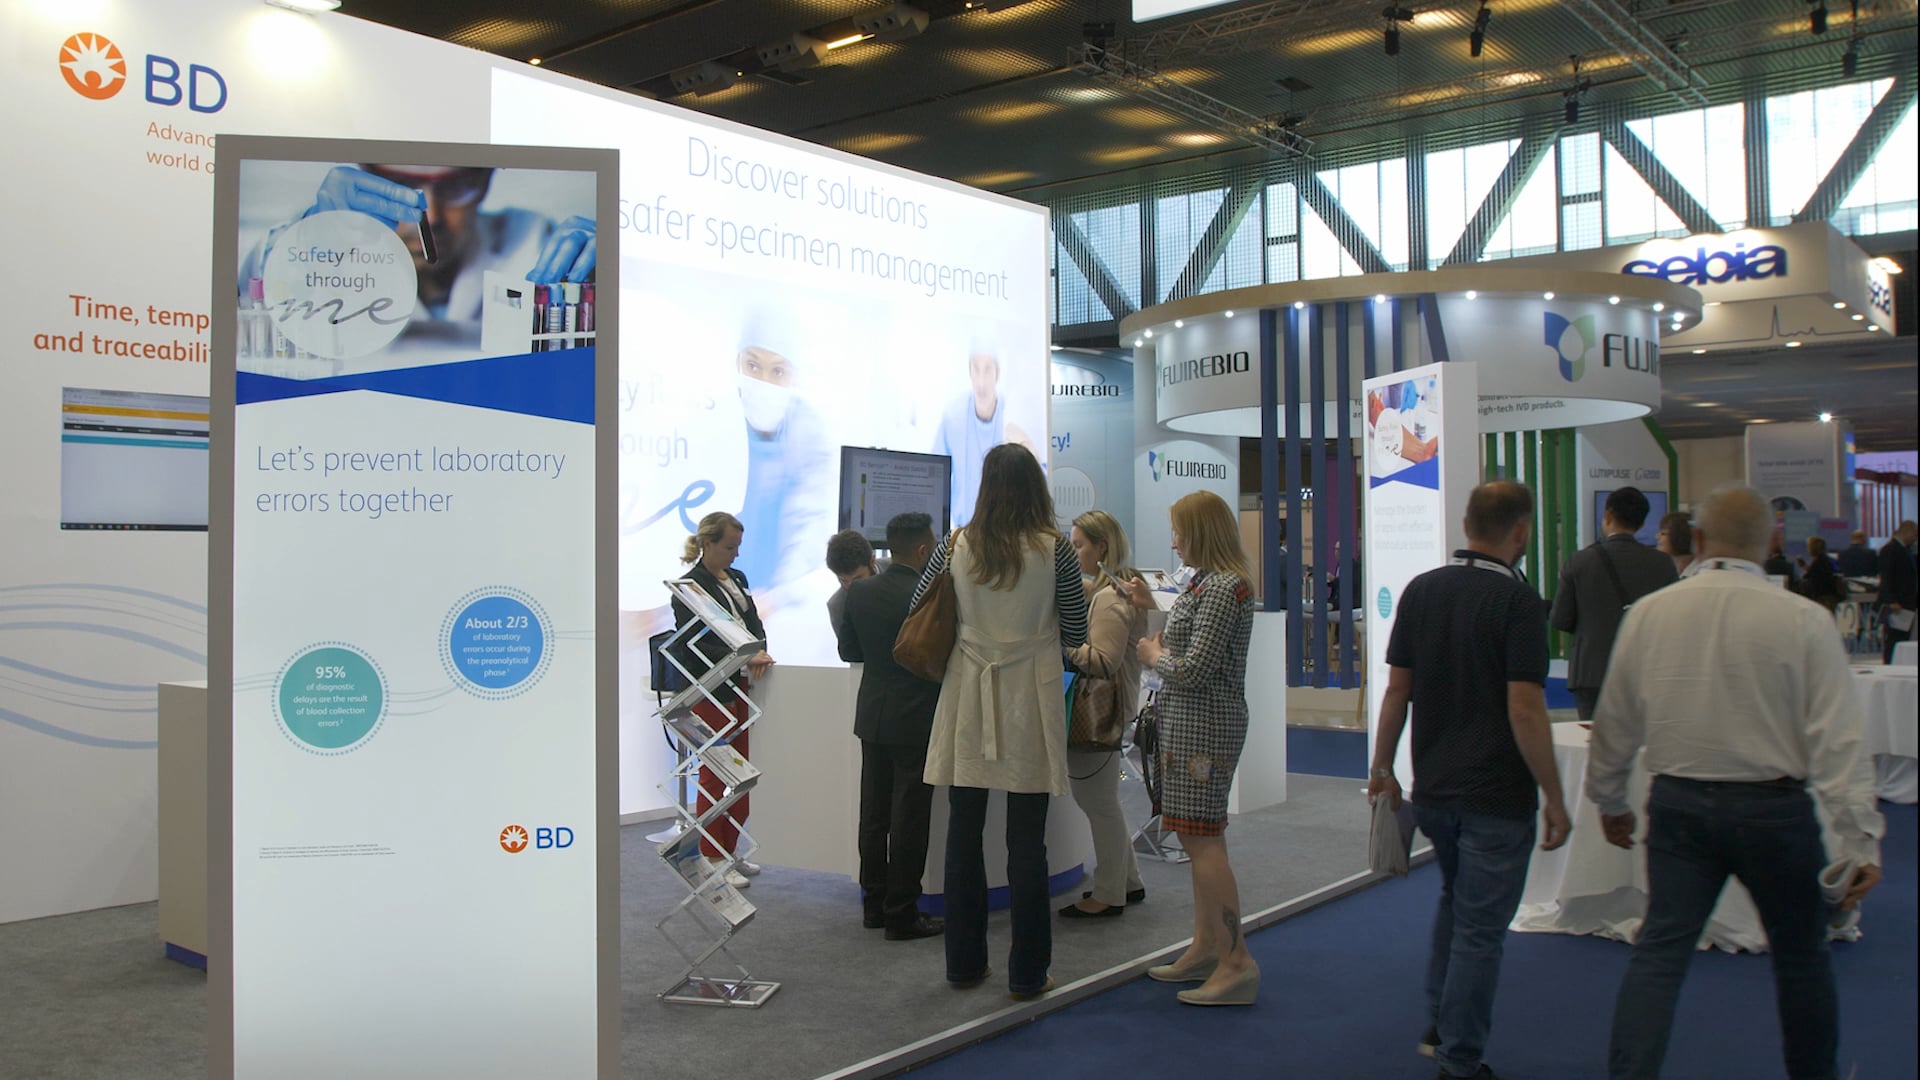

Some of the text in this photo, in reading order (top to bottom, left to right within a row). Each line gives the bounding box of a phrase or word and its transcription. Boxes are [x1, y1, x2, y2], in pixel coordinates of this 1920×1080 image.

[145, 54, 228, 114] BD
[146, 151, 199, 171] world
[688, 136, 928, 229] Discover solutions
[287, 246, 395, 267] Safety flows
[619, 195, 1009, 300] safer specimen management
[305, 272, 375, 292] through
[69, 294, 209, 334] Time, temp
[262, 297, 416, 325] me
[34, 331, 210, 363] and traceabili
[1162, 351, 1249, 388] FUJIREBIO
[1515, 402, 1530, 412] IVD
[258, 446, 566, 479] Let's prevent laboratory
[1167, 460, 1226, 480] FUJIREBIO
[256, 487, 453, 519] errors together
[465, 616, 528, 629] About 2/3
[473, 633, 520, 642] of laboratory
[507, 645, 531, 654] during
[467, 657, 529, 666] the preanalytical
[315, 666, 346, 679] 95%
[484, 669, 506, 678] phase
[306, 683, 355, 693] of diagnostic
[293, 695, 317, 704] delays
[333, 695, 346, 703] the
[347, 695, 368, 703] result
[296, 706, 365, 715] of blood collection
[536, 827, 574, 849] BD
